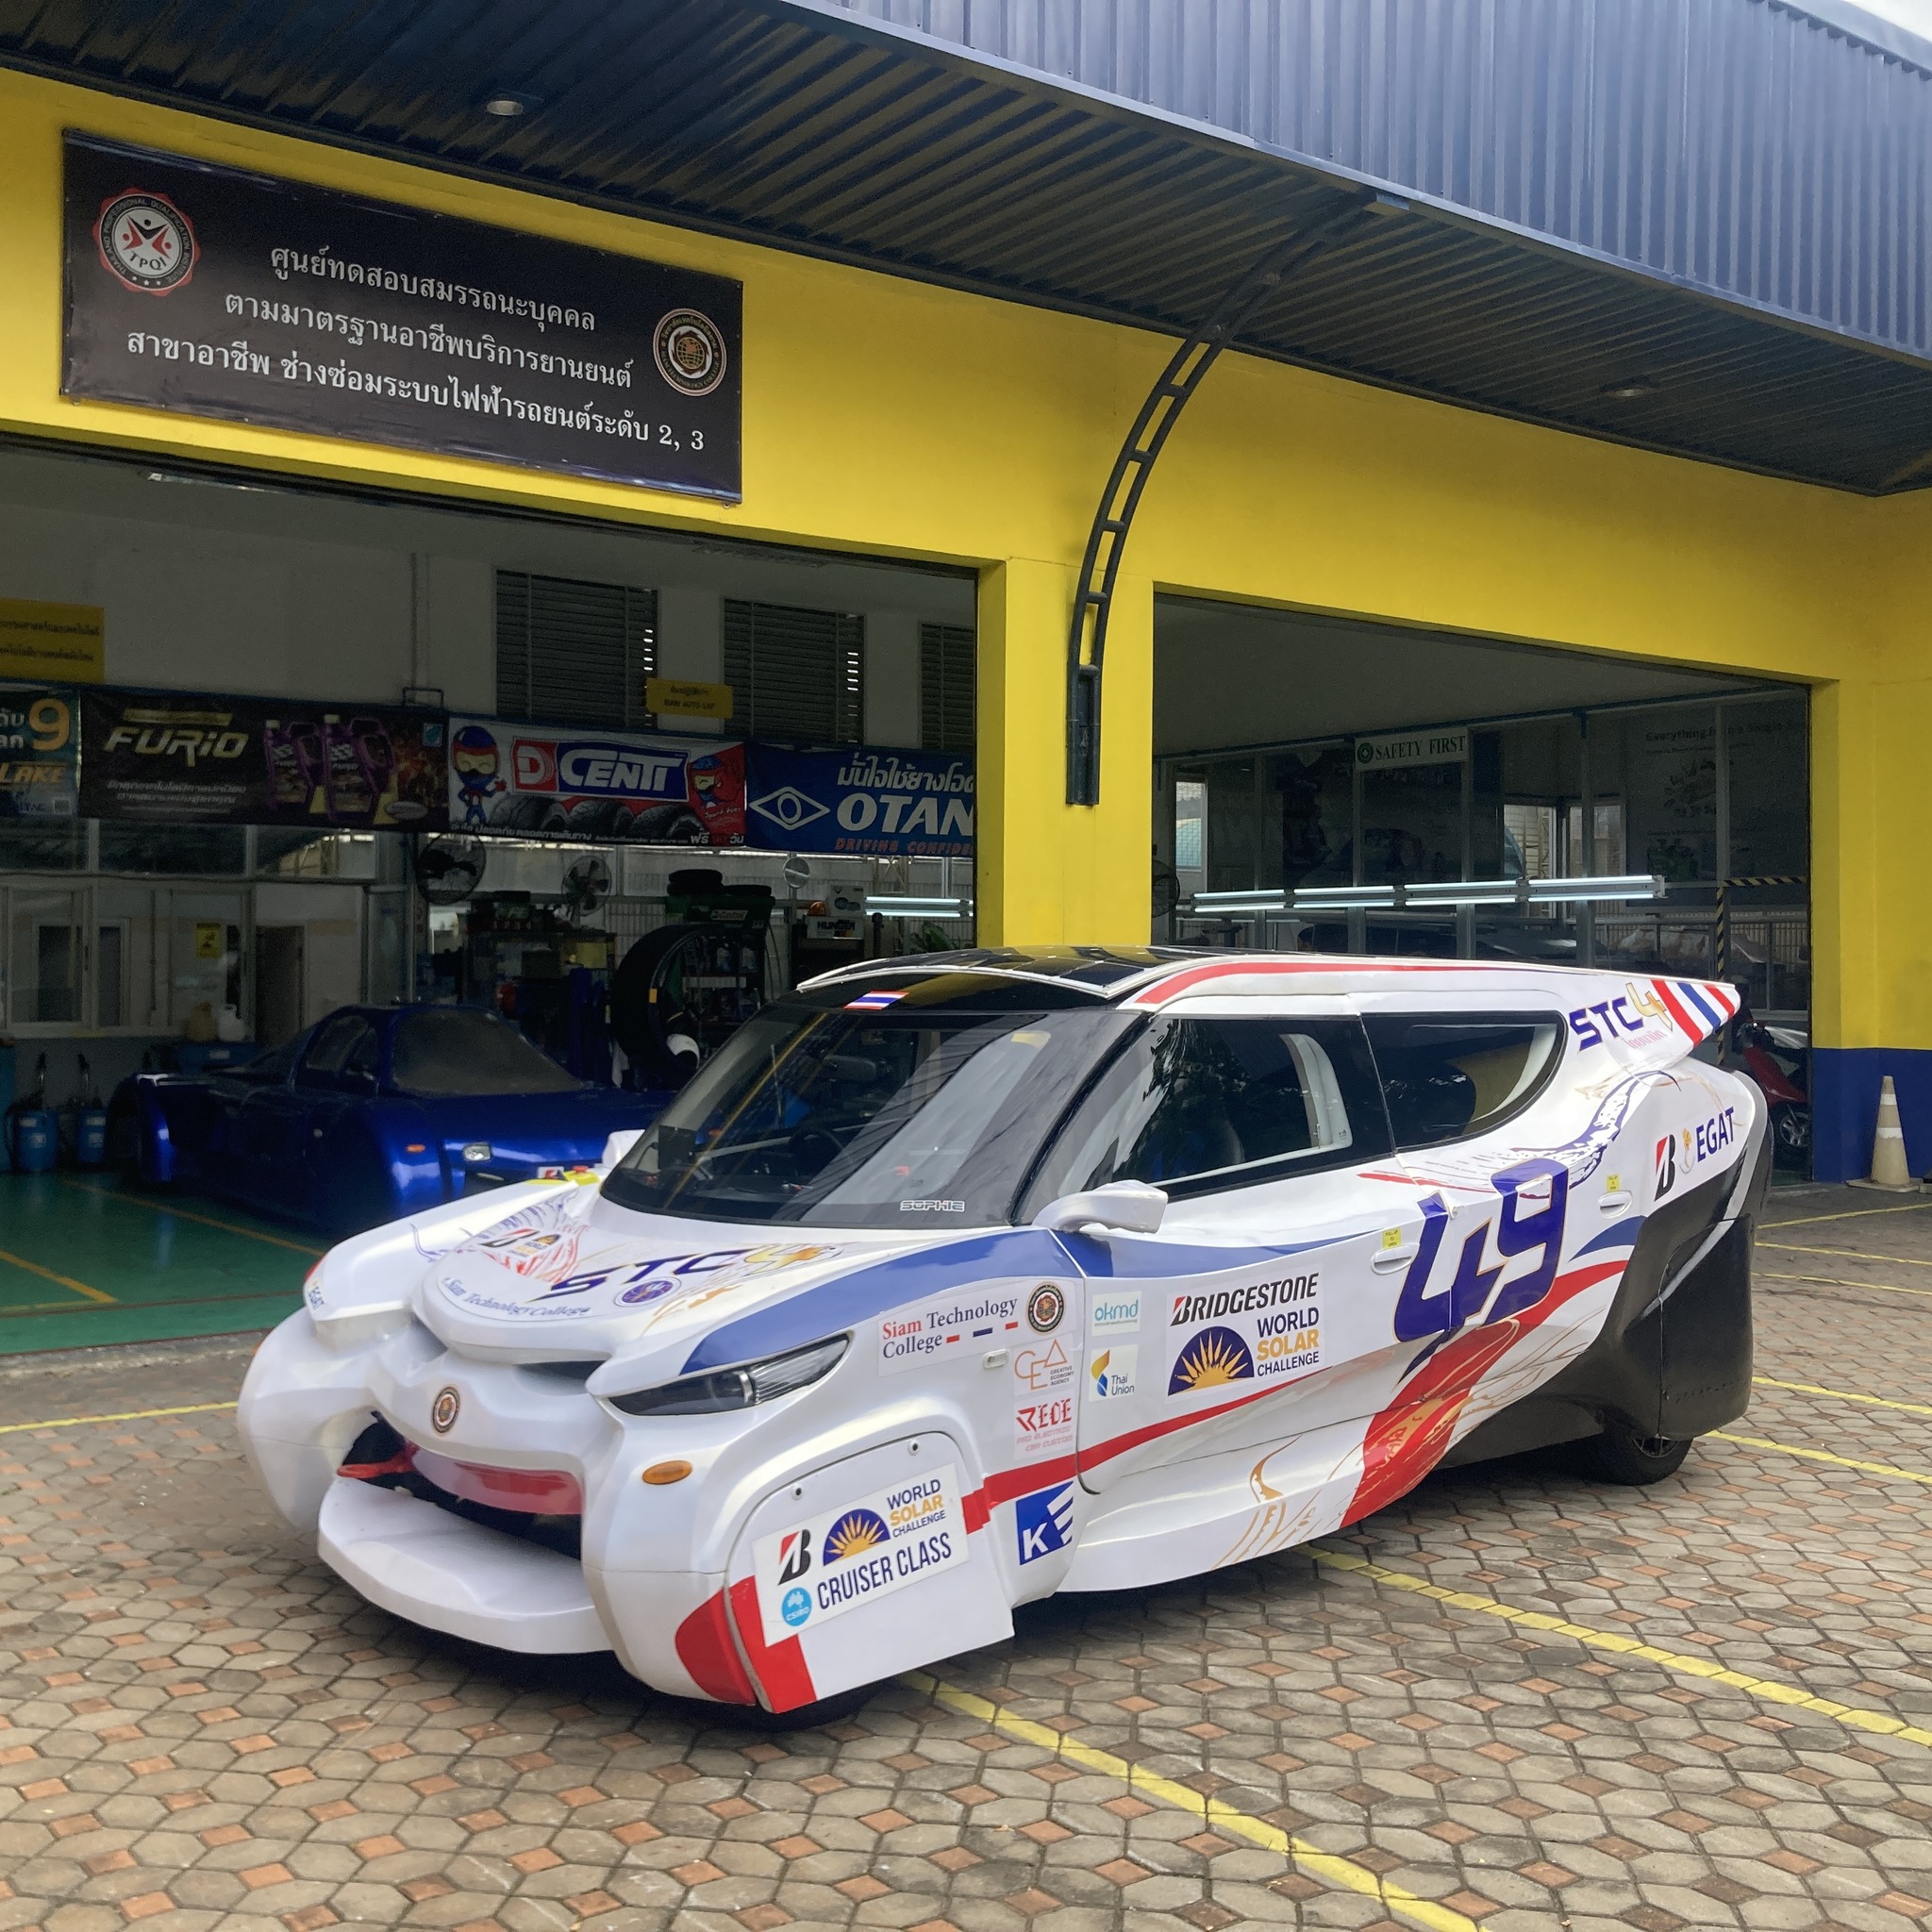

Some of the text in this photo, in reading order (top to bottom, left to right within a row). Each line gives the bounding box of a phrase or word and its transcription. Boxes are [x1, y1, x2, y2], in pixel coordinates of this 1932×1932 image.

[129, 250, 167, 271] TPQI
[271, 244, 595, 332] ศูนย์ทดสอบสมรรถนะบุคคล
[225, 292, 633, 388] ตามมาตรฐานอาชีพบริการยานยนต์
[127, 331, 705, 452] สาขาอาชีพ ช่างซ่อมระบบไฟฟ้ารถยนต์ระดับ 2, 3
[28, 698, 70, 751] 9
[1375, 735, 1466, 760] SAFETY FIRST
[835, 838, 899, 852] DRIVING
[1696, 1107, 1734, 1162] EGAT
[900, 1199, 966, 1213] SOPHIE
[1393, 1158, 1569, 1342] 49
[462, 1292, 531, 1315] Technology
[1095, 1298, 1139, 1322] okmd
[1170, 1272, 1319, 1326] BRIDGESTONE
[882, 1321, 923, 1341] Siam
[926, 1298, 1018, 1329] Technology
[1257, 1307, 1319, 1338] WORLD
[883, 1334, 942, 1358] College
[1257, 1328, 1319, 1361] SOLAR
[1050, 1371, 1074, 1380] ECONOMY
[1257, 1351, 1319, 1377] CHALLENGE
[1050, 1377, 1070, 1386] AGENCY
[1111, 1373, 1128, 1386] Thai
[1111, 1384, 1135, 1395] Union
[887, 1478, 941, 1509] WORLD
[890, 1494, 944, 1526] SOLAR
[891, 1510, 946, 1538] CHALLENGE
[817, 1531, 952, 1610] CRUISER CLASS
